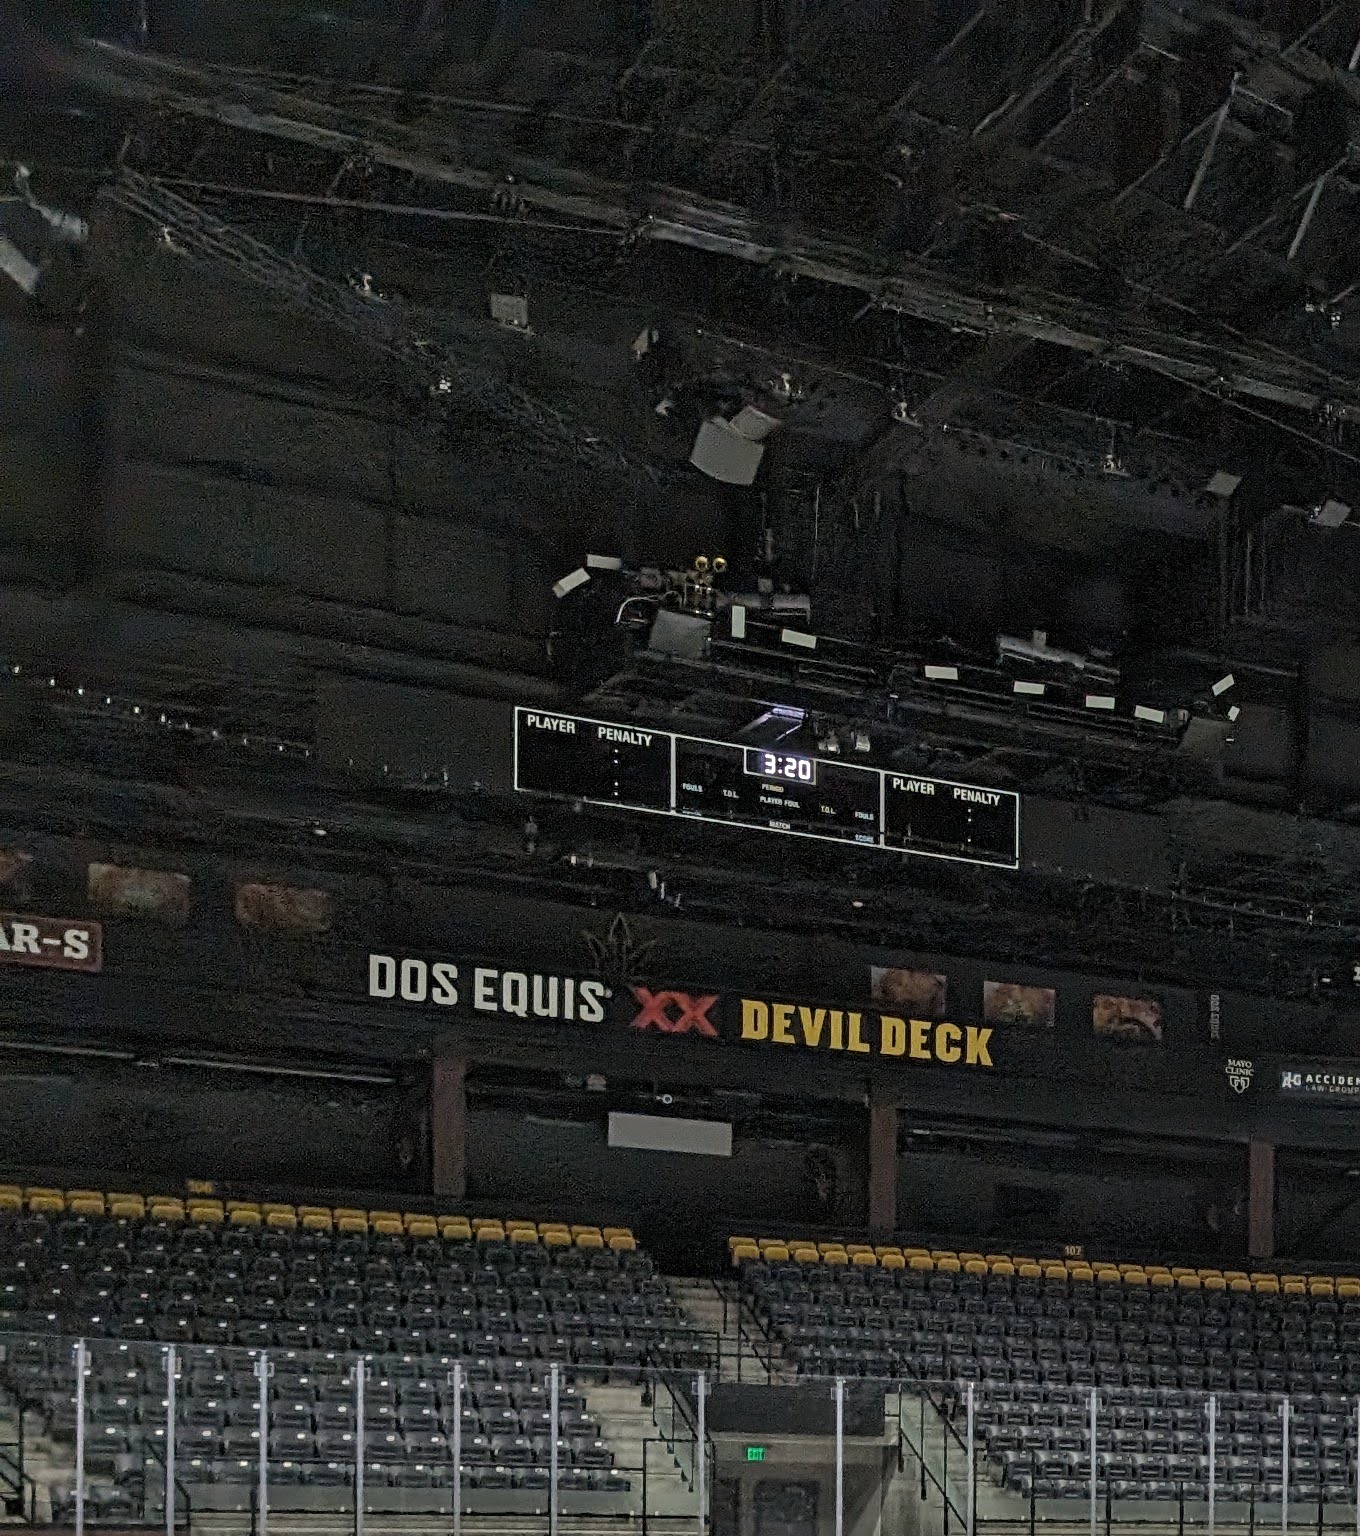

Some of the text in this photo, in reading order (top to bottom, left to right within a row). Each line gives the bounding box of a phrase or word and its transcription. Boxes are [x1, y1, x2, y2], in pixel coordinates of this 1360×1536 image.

[527, 713, 652, 747] PLAYER PENALTY
[763, 753, 811, 780] 3:20
[892, 777, 1000, 806] PLAYER PENALTY
[369, 954, 719, 1037] DOS EQUIS XX
[740, 999, 995, 1067] DEVIL DECK
[1225, 1066, 1254, 1077] CLINIC
[1227, 1058, 1253, 1068] MAYO
